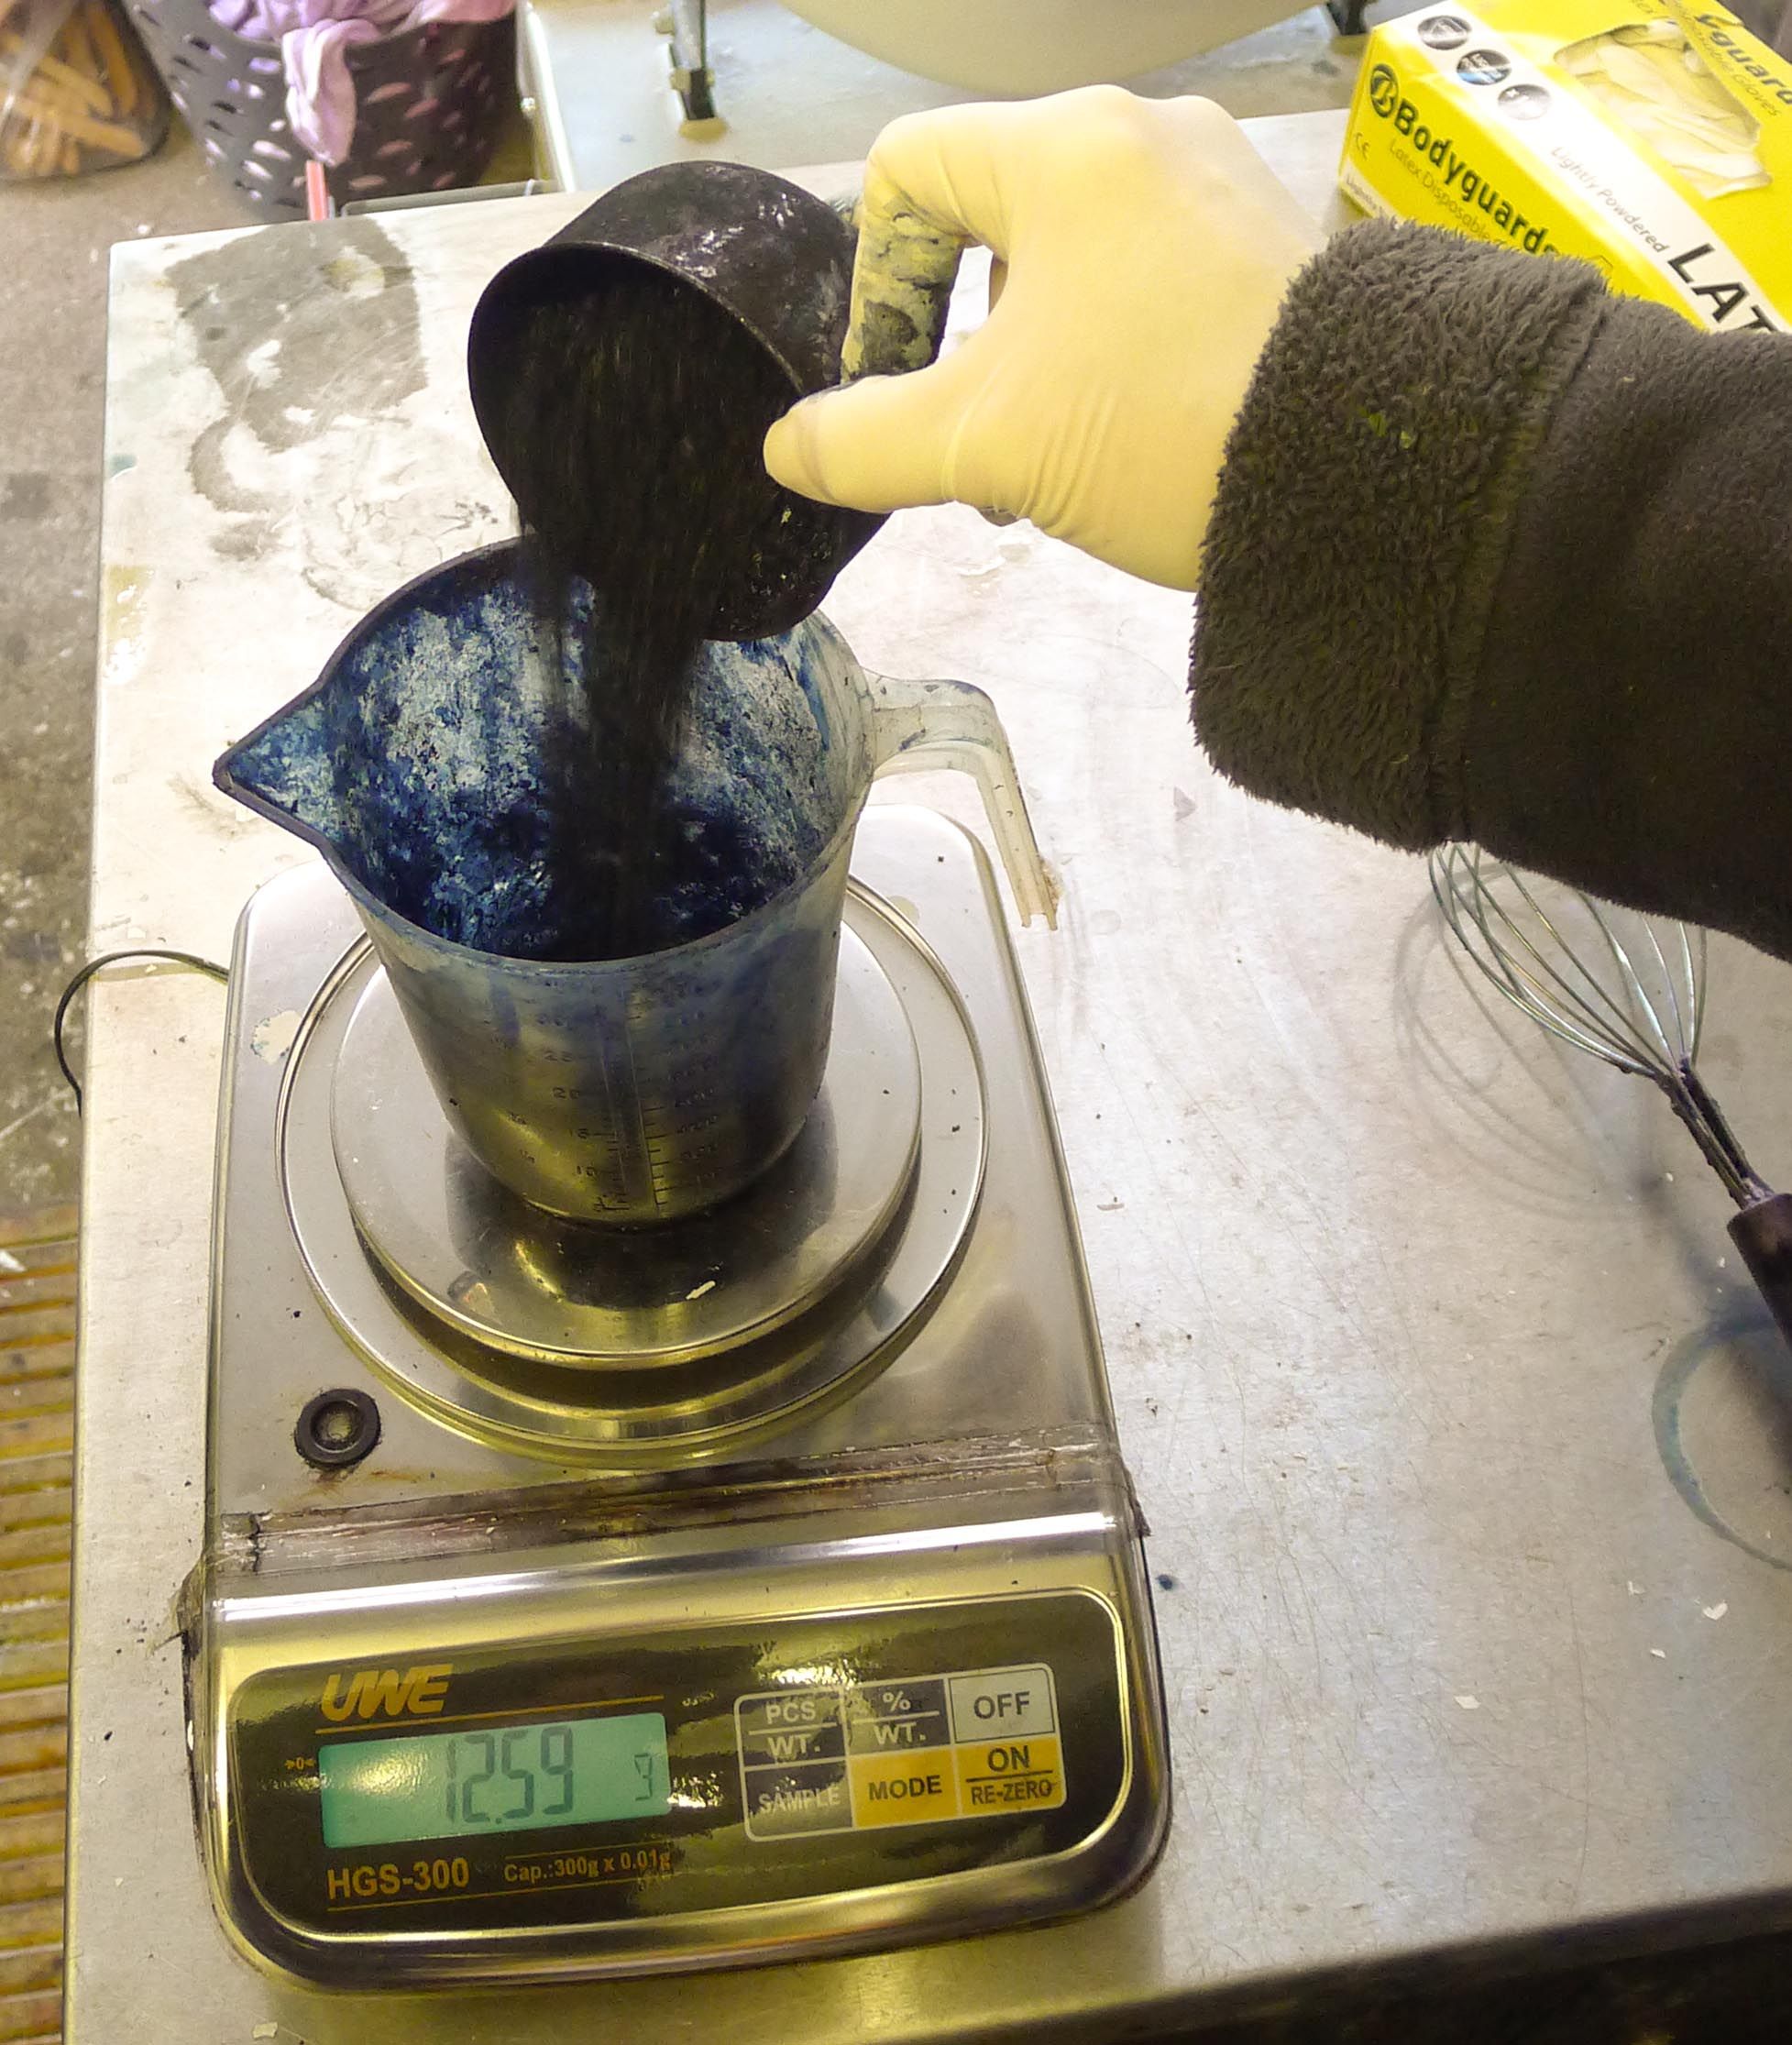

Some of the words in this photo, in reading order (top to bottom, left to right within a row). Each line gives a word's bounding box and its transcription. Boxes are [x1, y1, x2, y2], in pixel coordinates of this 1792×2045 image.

[1389, 139, 1420, 180] Latex
[1422, 171, 1490, 240] Disposable
[1550, 146, 1600, 190] Lightly
[1597, 189, 1670, 253] Powdered
[321, 1663, 455, 1721] UWE
[973, 1689, 1031, 1721] OFF
[764, 1700, 817, 1725] PCS
[767, 1732, 822, 1757] WT.
[873, 1723, 928, 1745] WT.
[986, 1744, 1030, 1773] ON
[757, 1784, 841, 1815] SAMPLE
[867, 1774, 943, 1801] MODE
[970, 1778, 1053, 1807] RE-ZERO
[604, 1856, 616, 1874] x
[620, 1848, 671, 1871] 0.01g
[326, 1857, 470, 1901] HGS-300
